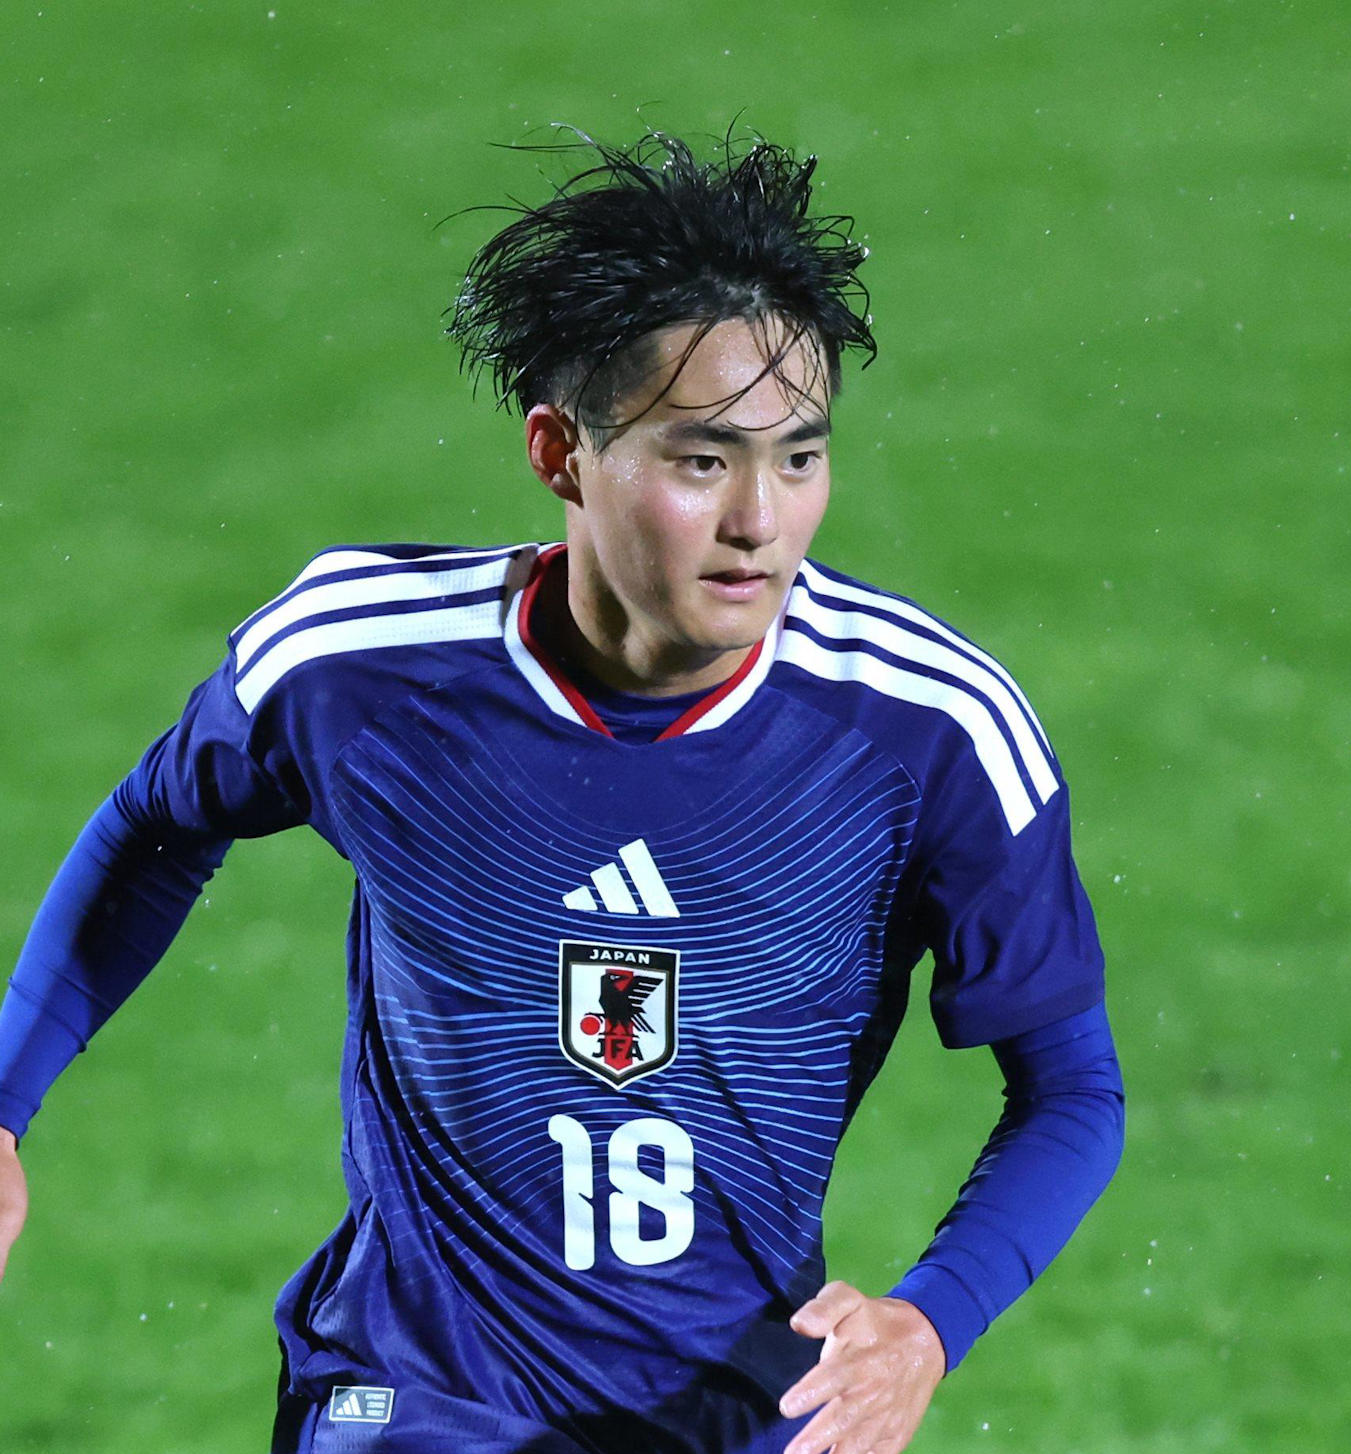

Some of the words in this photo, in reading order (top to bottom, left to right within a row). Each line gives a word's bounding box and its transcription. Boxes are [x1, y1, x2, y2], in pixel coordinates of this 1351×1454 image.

[589, 949, 650, 965] JAPAN
[591, 1038, 644, 1061] JFA
[548, 1114, 694, 1270] 18
